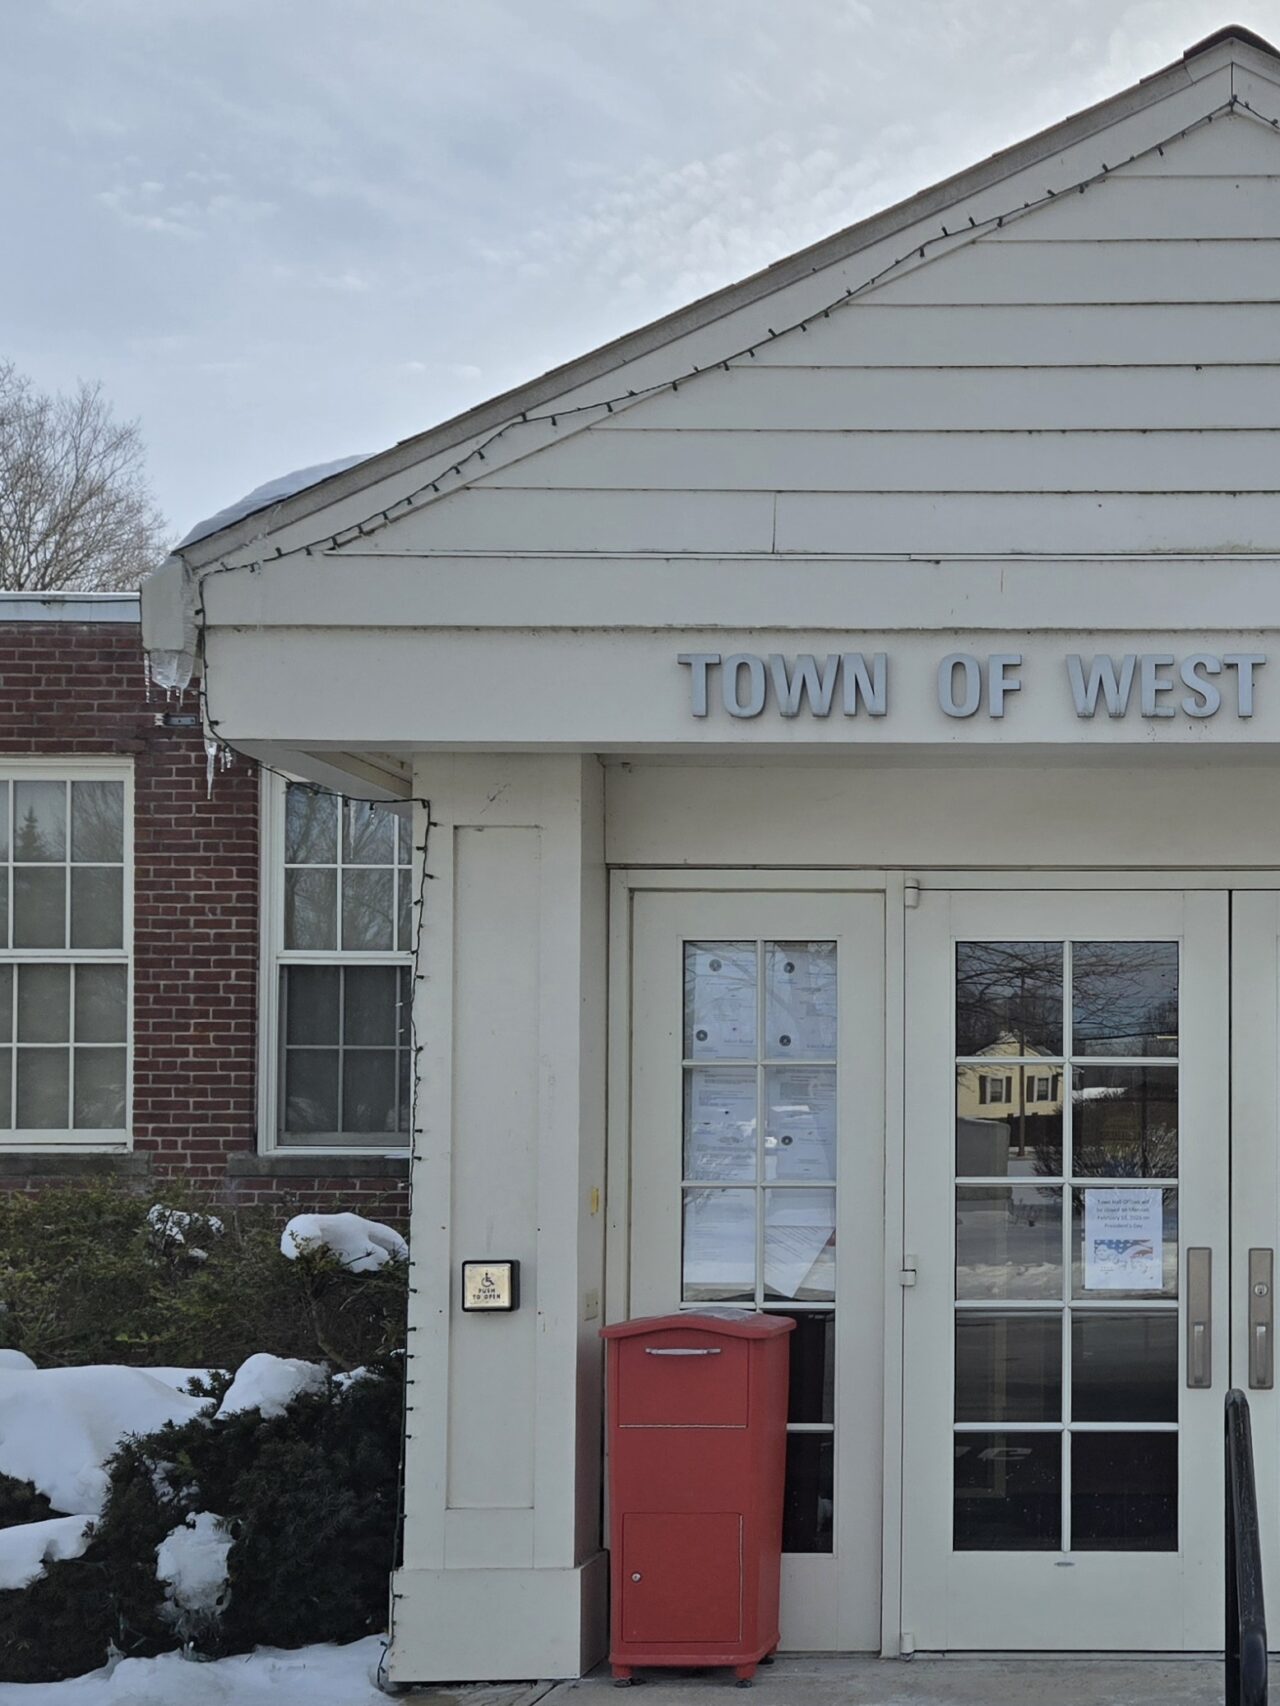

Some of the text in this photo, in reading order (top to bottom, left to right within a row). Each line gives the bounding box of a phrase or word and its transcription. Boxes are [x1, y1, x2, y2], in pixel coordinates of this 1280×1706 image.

[678, 652, 888, 718] TOWN
[936, 653, 1022, 718] OF
[1065, 653, 1267, 718] WEST
